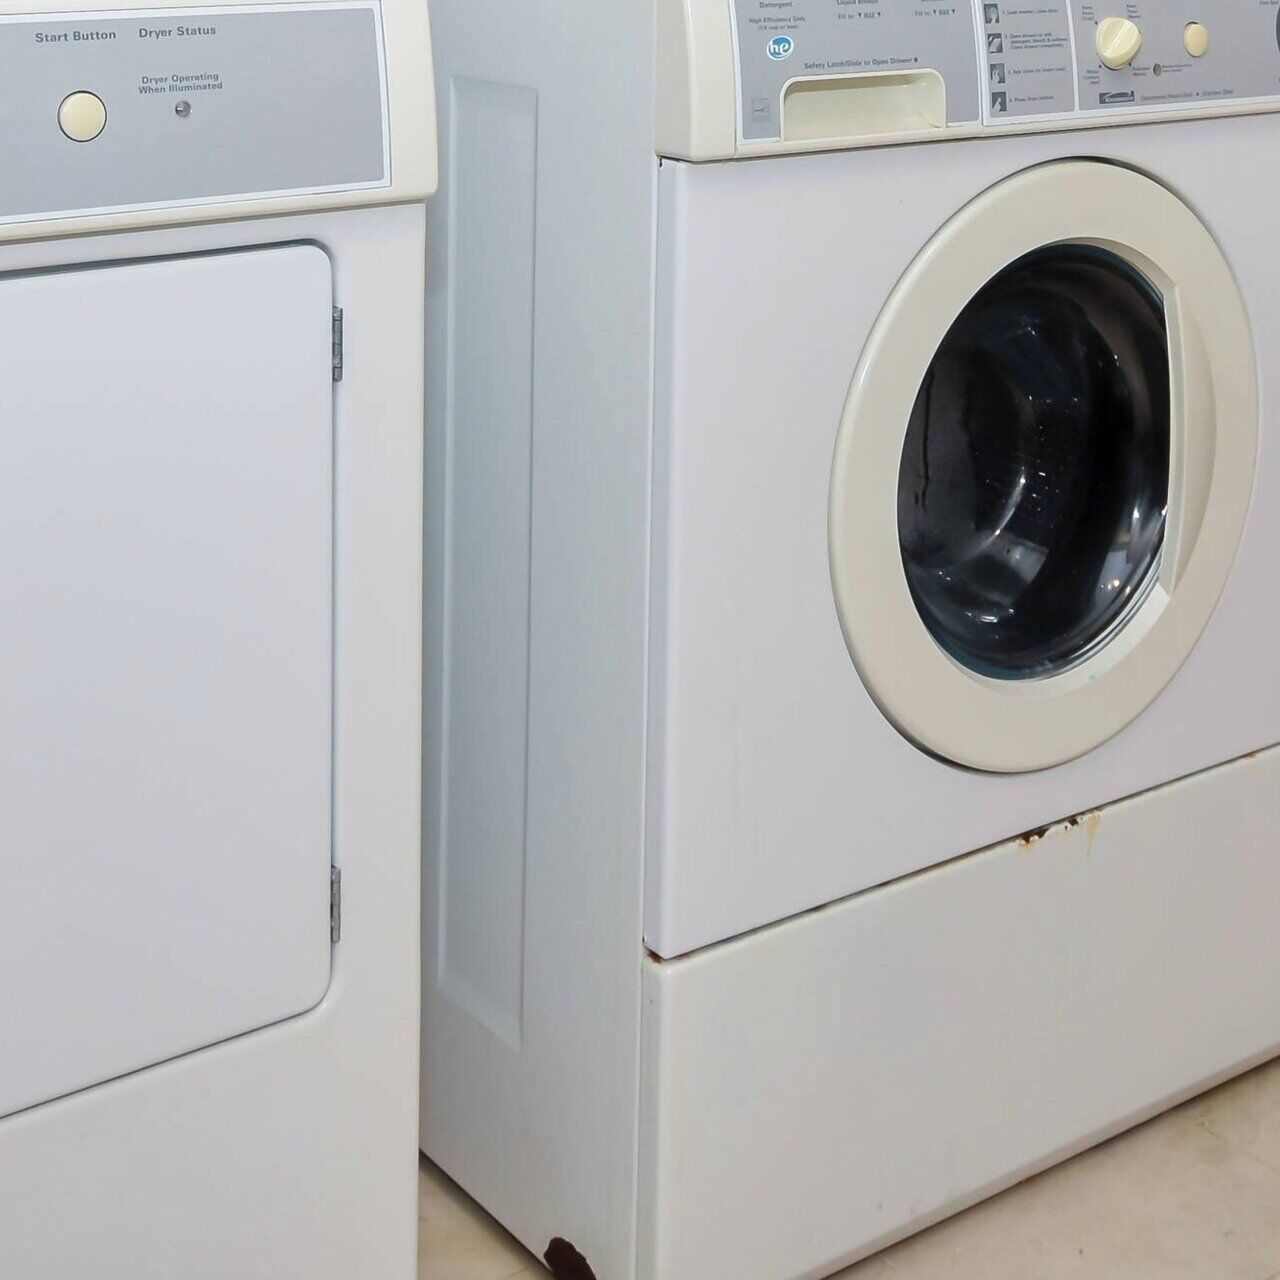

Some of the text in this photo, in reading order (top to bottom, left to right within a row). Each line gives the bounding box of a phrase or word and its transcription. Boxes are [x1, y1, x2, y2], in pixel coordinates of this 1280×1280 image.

[35, 31, 117, 43] Start Button
[139, 26, 216, 40] Dryer Status
[141, 72, 219, 86] Dryer Operating
[138, 82, 223, 94] When Illuminated
